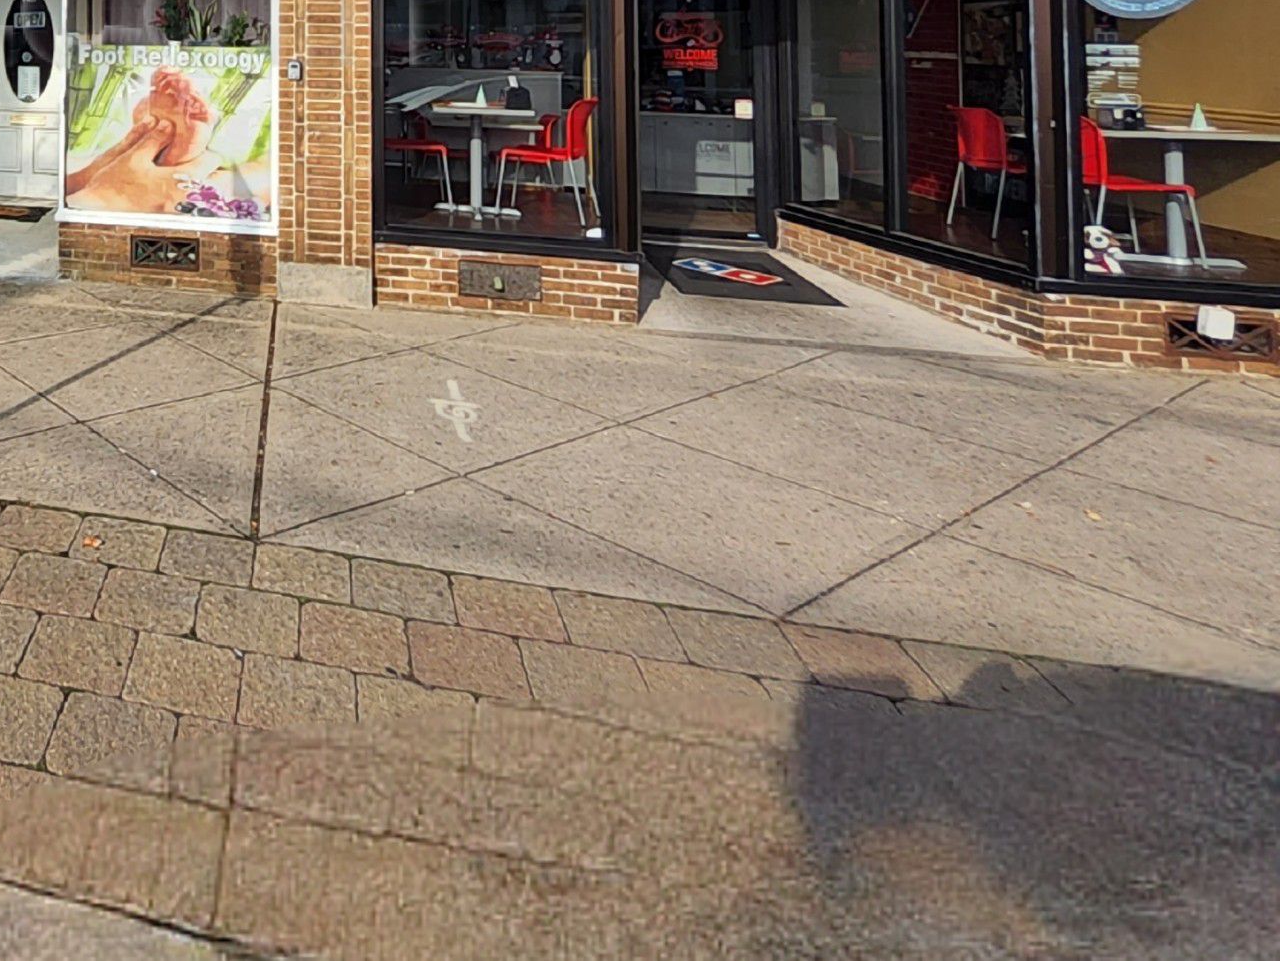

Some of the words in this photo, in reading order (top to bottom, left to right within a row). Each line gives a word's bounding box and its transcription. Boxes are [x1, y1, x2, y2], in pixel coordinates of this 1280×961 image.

[77, 43, 125, 65] Foot
[132, 41, 266, 74] Reflexology
[663, 48, 718, 60] WELCOME
